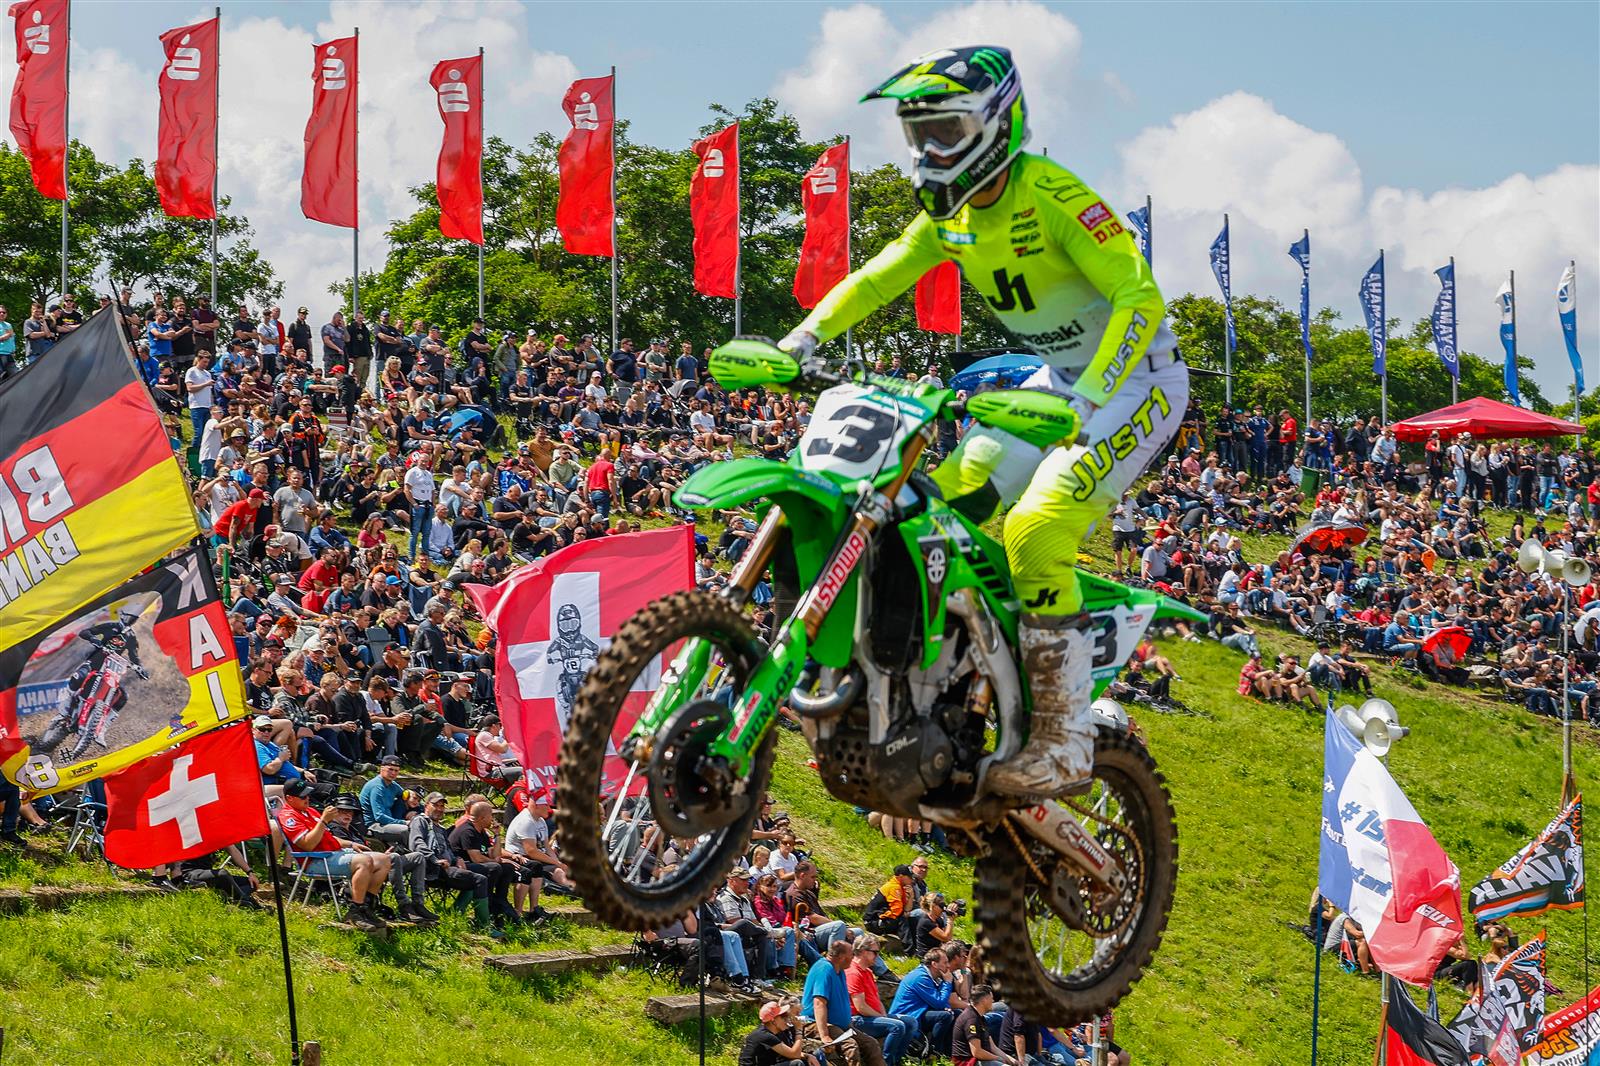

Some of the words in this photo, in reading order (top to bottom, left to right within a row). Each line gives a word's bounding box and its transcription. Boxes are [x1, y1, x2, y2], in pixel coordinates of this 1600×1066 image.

[1102, 310, 1149, 393] JUST1
[807, 404, 901, 463] 3
[1071, 385, 1172, 502] JUST1
[817, 531, 866, 609] SHOWA
[1090, 614, 1118, 668] 3
